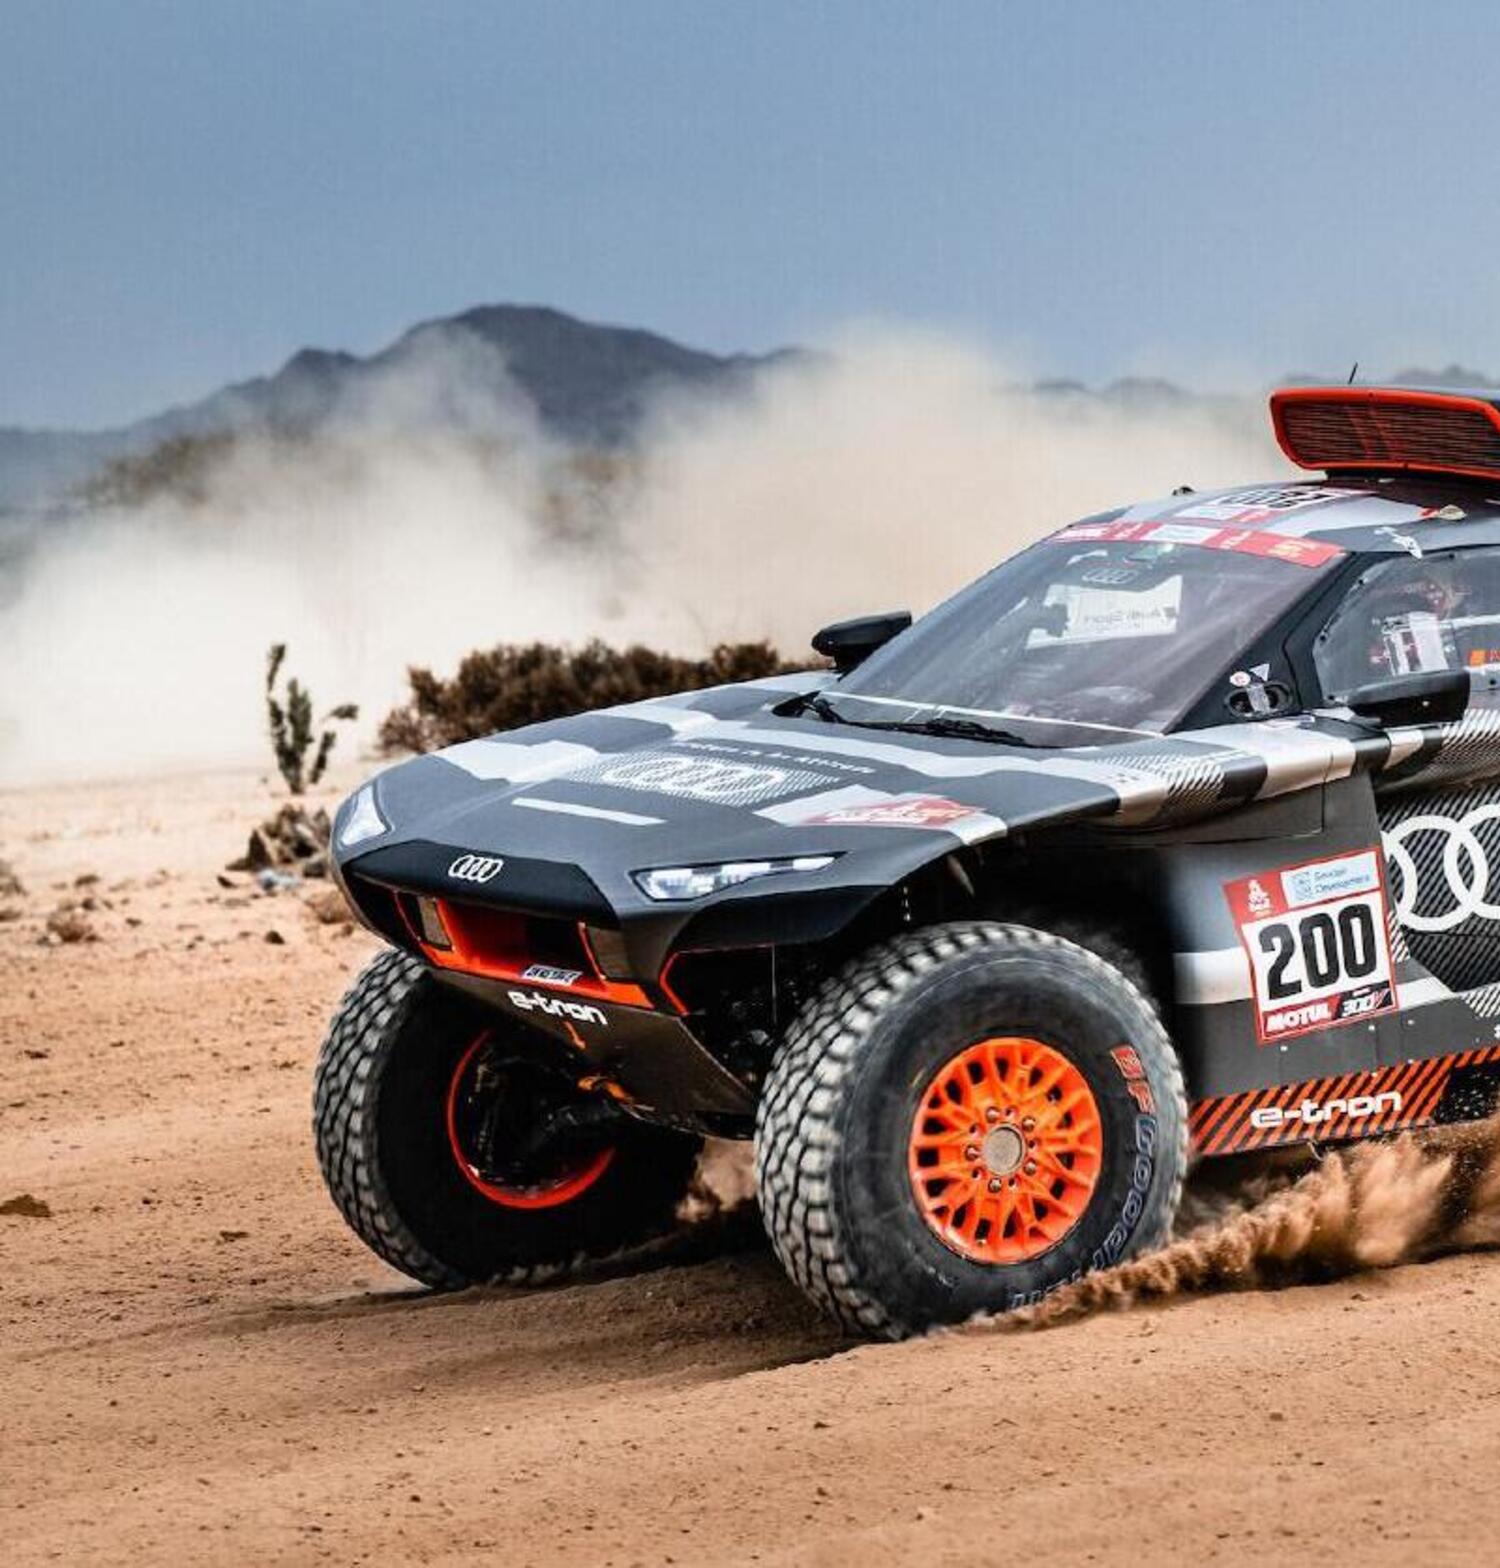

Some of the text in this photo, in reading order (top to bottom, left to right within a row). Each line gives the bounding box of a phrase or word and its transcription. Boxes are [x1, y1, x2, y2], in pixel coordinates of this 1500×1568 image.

[1258, 903, 1377, 1001] 200
[507, 991, 608, 1025] e-tron
[1266, 1003, 1332, 1032] MOTUL
[1250, 1090, 1402, 1128] e-tron
